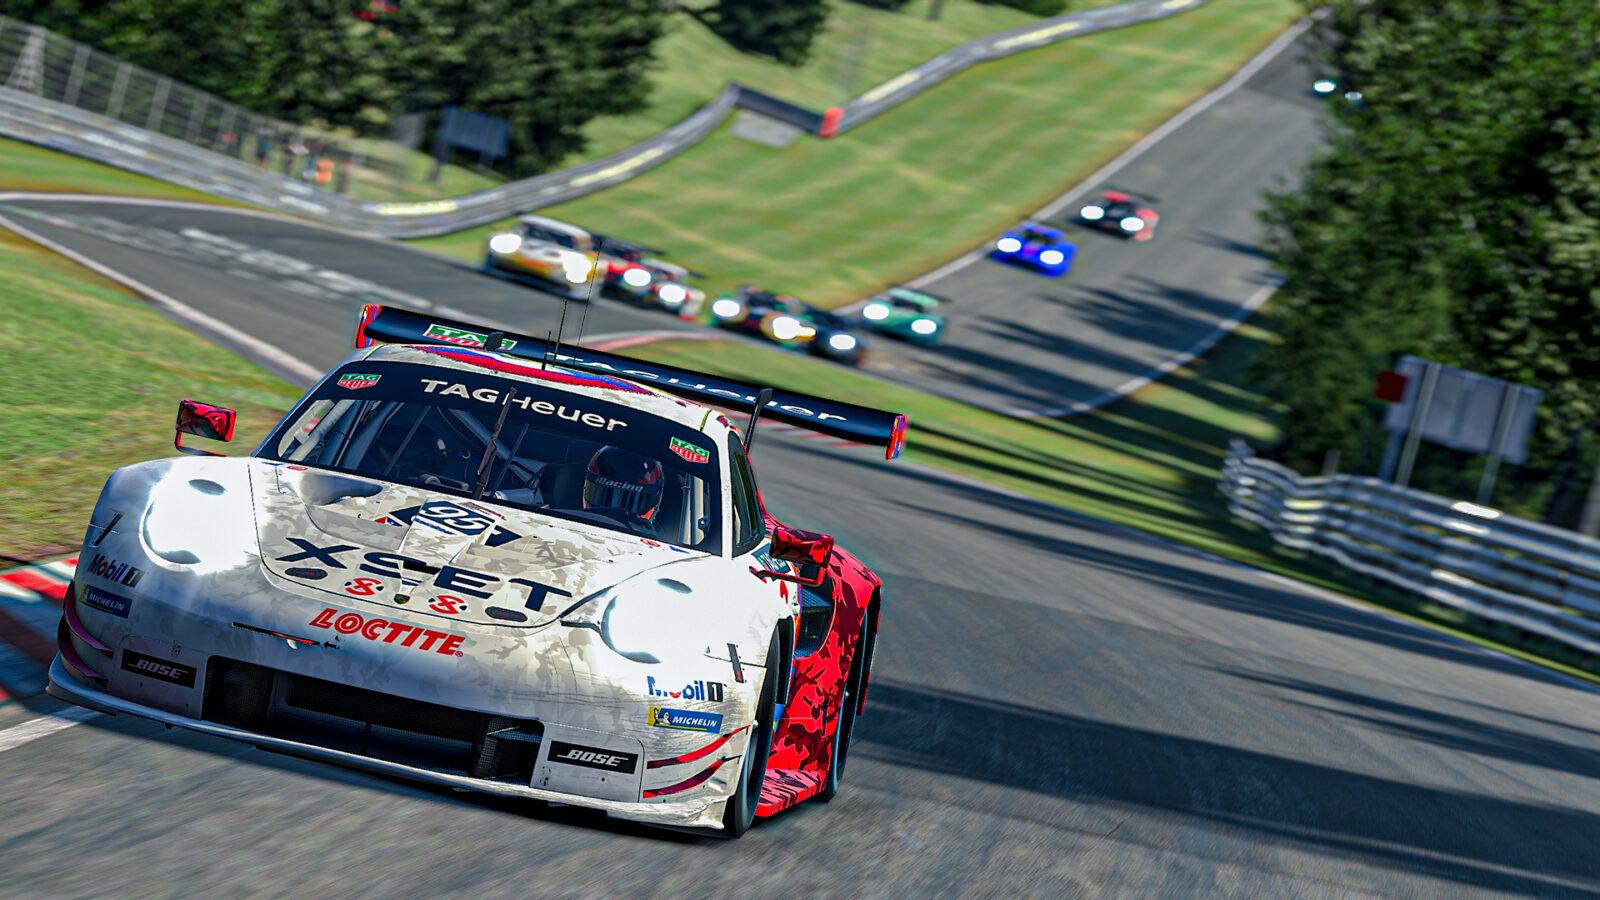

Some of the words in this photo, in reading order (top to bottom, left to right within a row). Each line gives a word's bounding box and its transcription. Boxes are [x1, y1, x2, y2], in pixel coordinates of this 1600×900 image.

[419, 506, 491, 531] 95
[87, 553, 128, 582] Mobil
[275, 537, 573, 612] XSET
[89, 593, 125, 611] MICHELIN
[127, 659, 189, 679] BOSE
[672, 716, 718, 728] MICHELIN
[556, 749, 629, 767] BOSE
